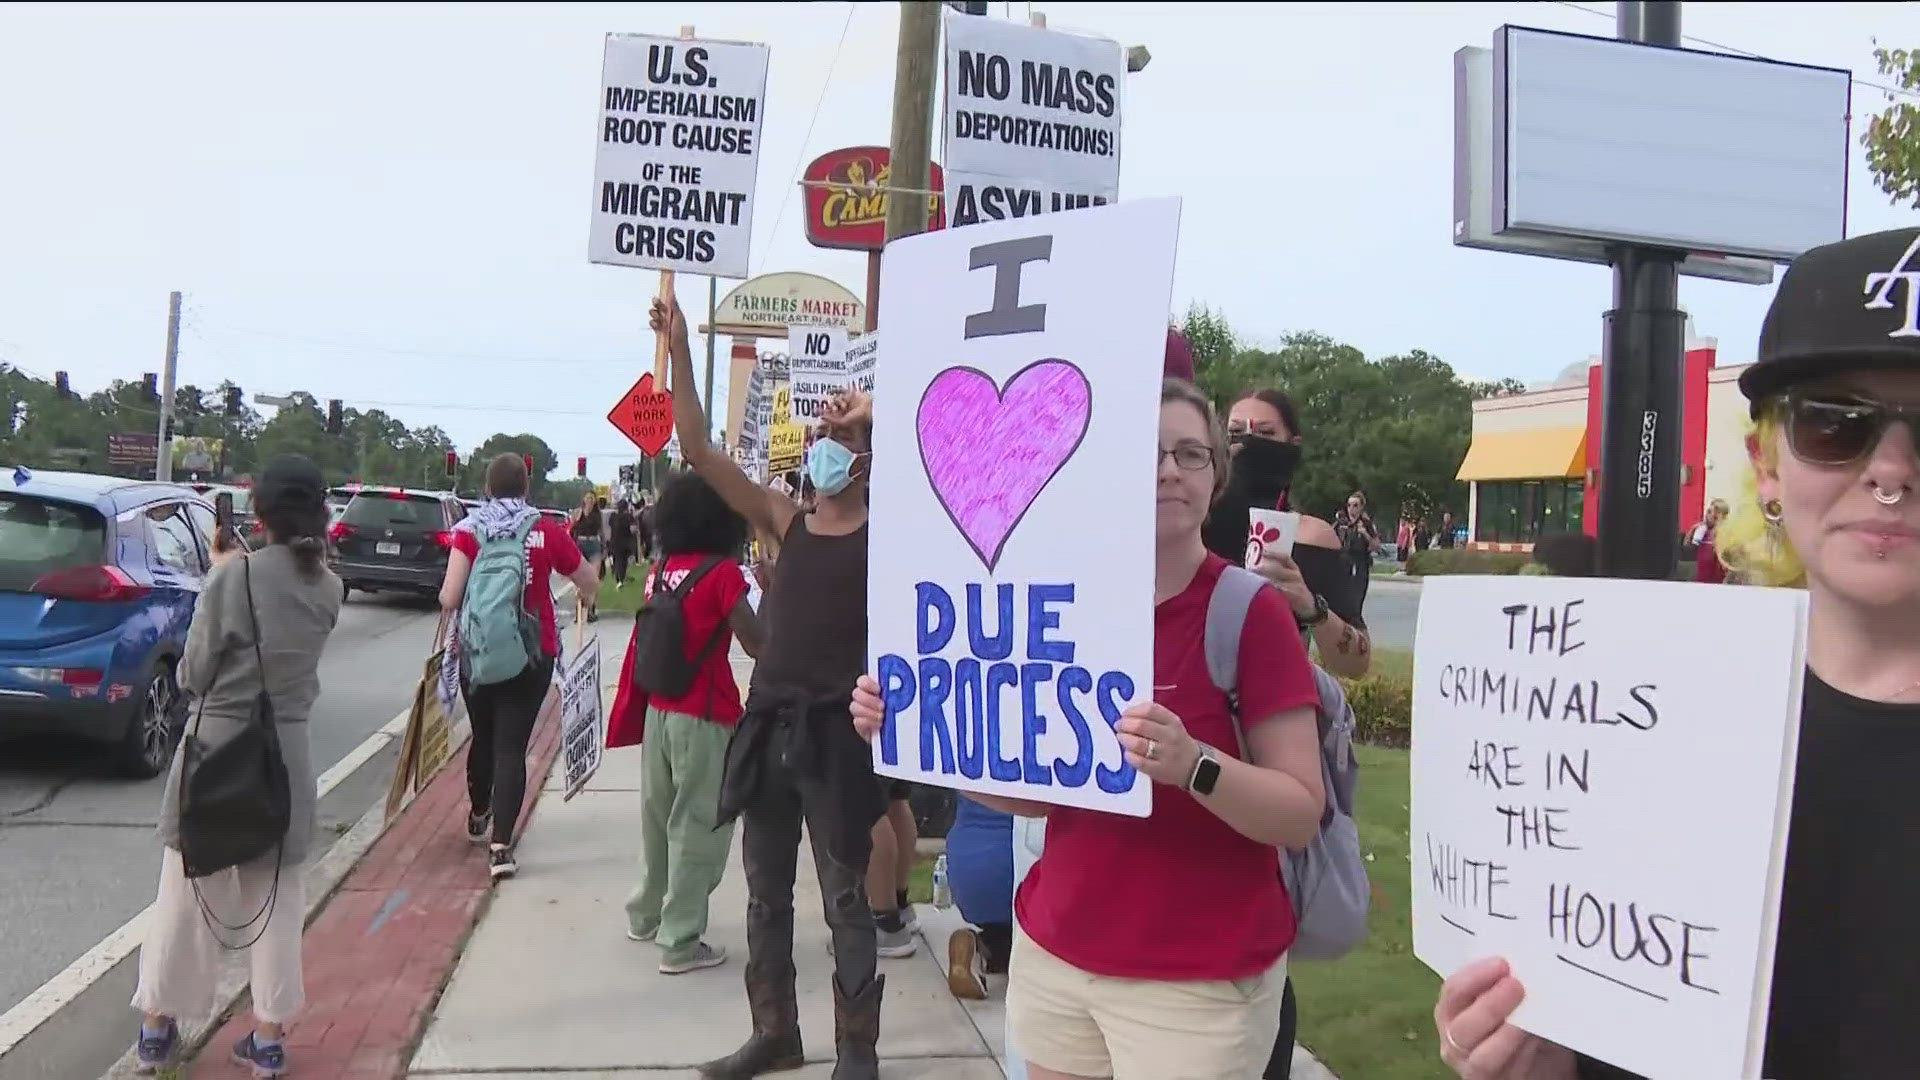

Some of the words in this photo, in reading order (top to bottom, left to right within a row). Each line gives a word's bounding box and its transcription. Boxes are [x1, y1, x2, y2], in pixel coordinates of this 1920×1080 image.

[648, 45, 717, 88] U.S.
[958, 51, 1010, 101] NO
[1021, 60, 1115, 118] MASS
[605, 87, 756, 122] IMPERIALISM
[604, 117, 667, 147] ROOT
[672, 123, 752, 155] CAUSE
[956, 110, 1114, 156] DEPORTATIONS!
[642, 163, 664, 181] OF
[669, 165, 701, 184] THE
[601, 182, 747, 226] MIGRANT
[615, 222, 716, 263] CRISIS
[734, 294, 798, 313] FARMERS
[801, 299, 859, 318] MARKET
[964, 235, 1053, 340] I
[742, 312, 809, 323] NORTHEAST
[804, 333, 831, 355] NO
[633, 394, 666, 406] ROAD
[633, 409, 666, 422] WORK
[631, 425, 656, 437] 1500
[1639, 412, 1656, 496] 3385
[915, 580, 1075, 664] DUE
[1503, 599, 1585, 655] THE
[1440, 664, 1658, 730] CRIMINALS
[877, 653, 1137, 794] PROCESS
[1468, 740, 1524, 789] ARE
[1545, 748, 1589, 793] IN
[1497, 804, 1583, 850] THE
[1426, 831, 1517, 920] WHITE
[1549, 883, 1720, 994] HOUSE
